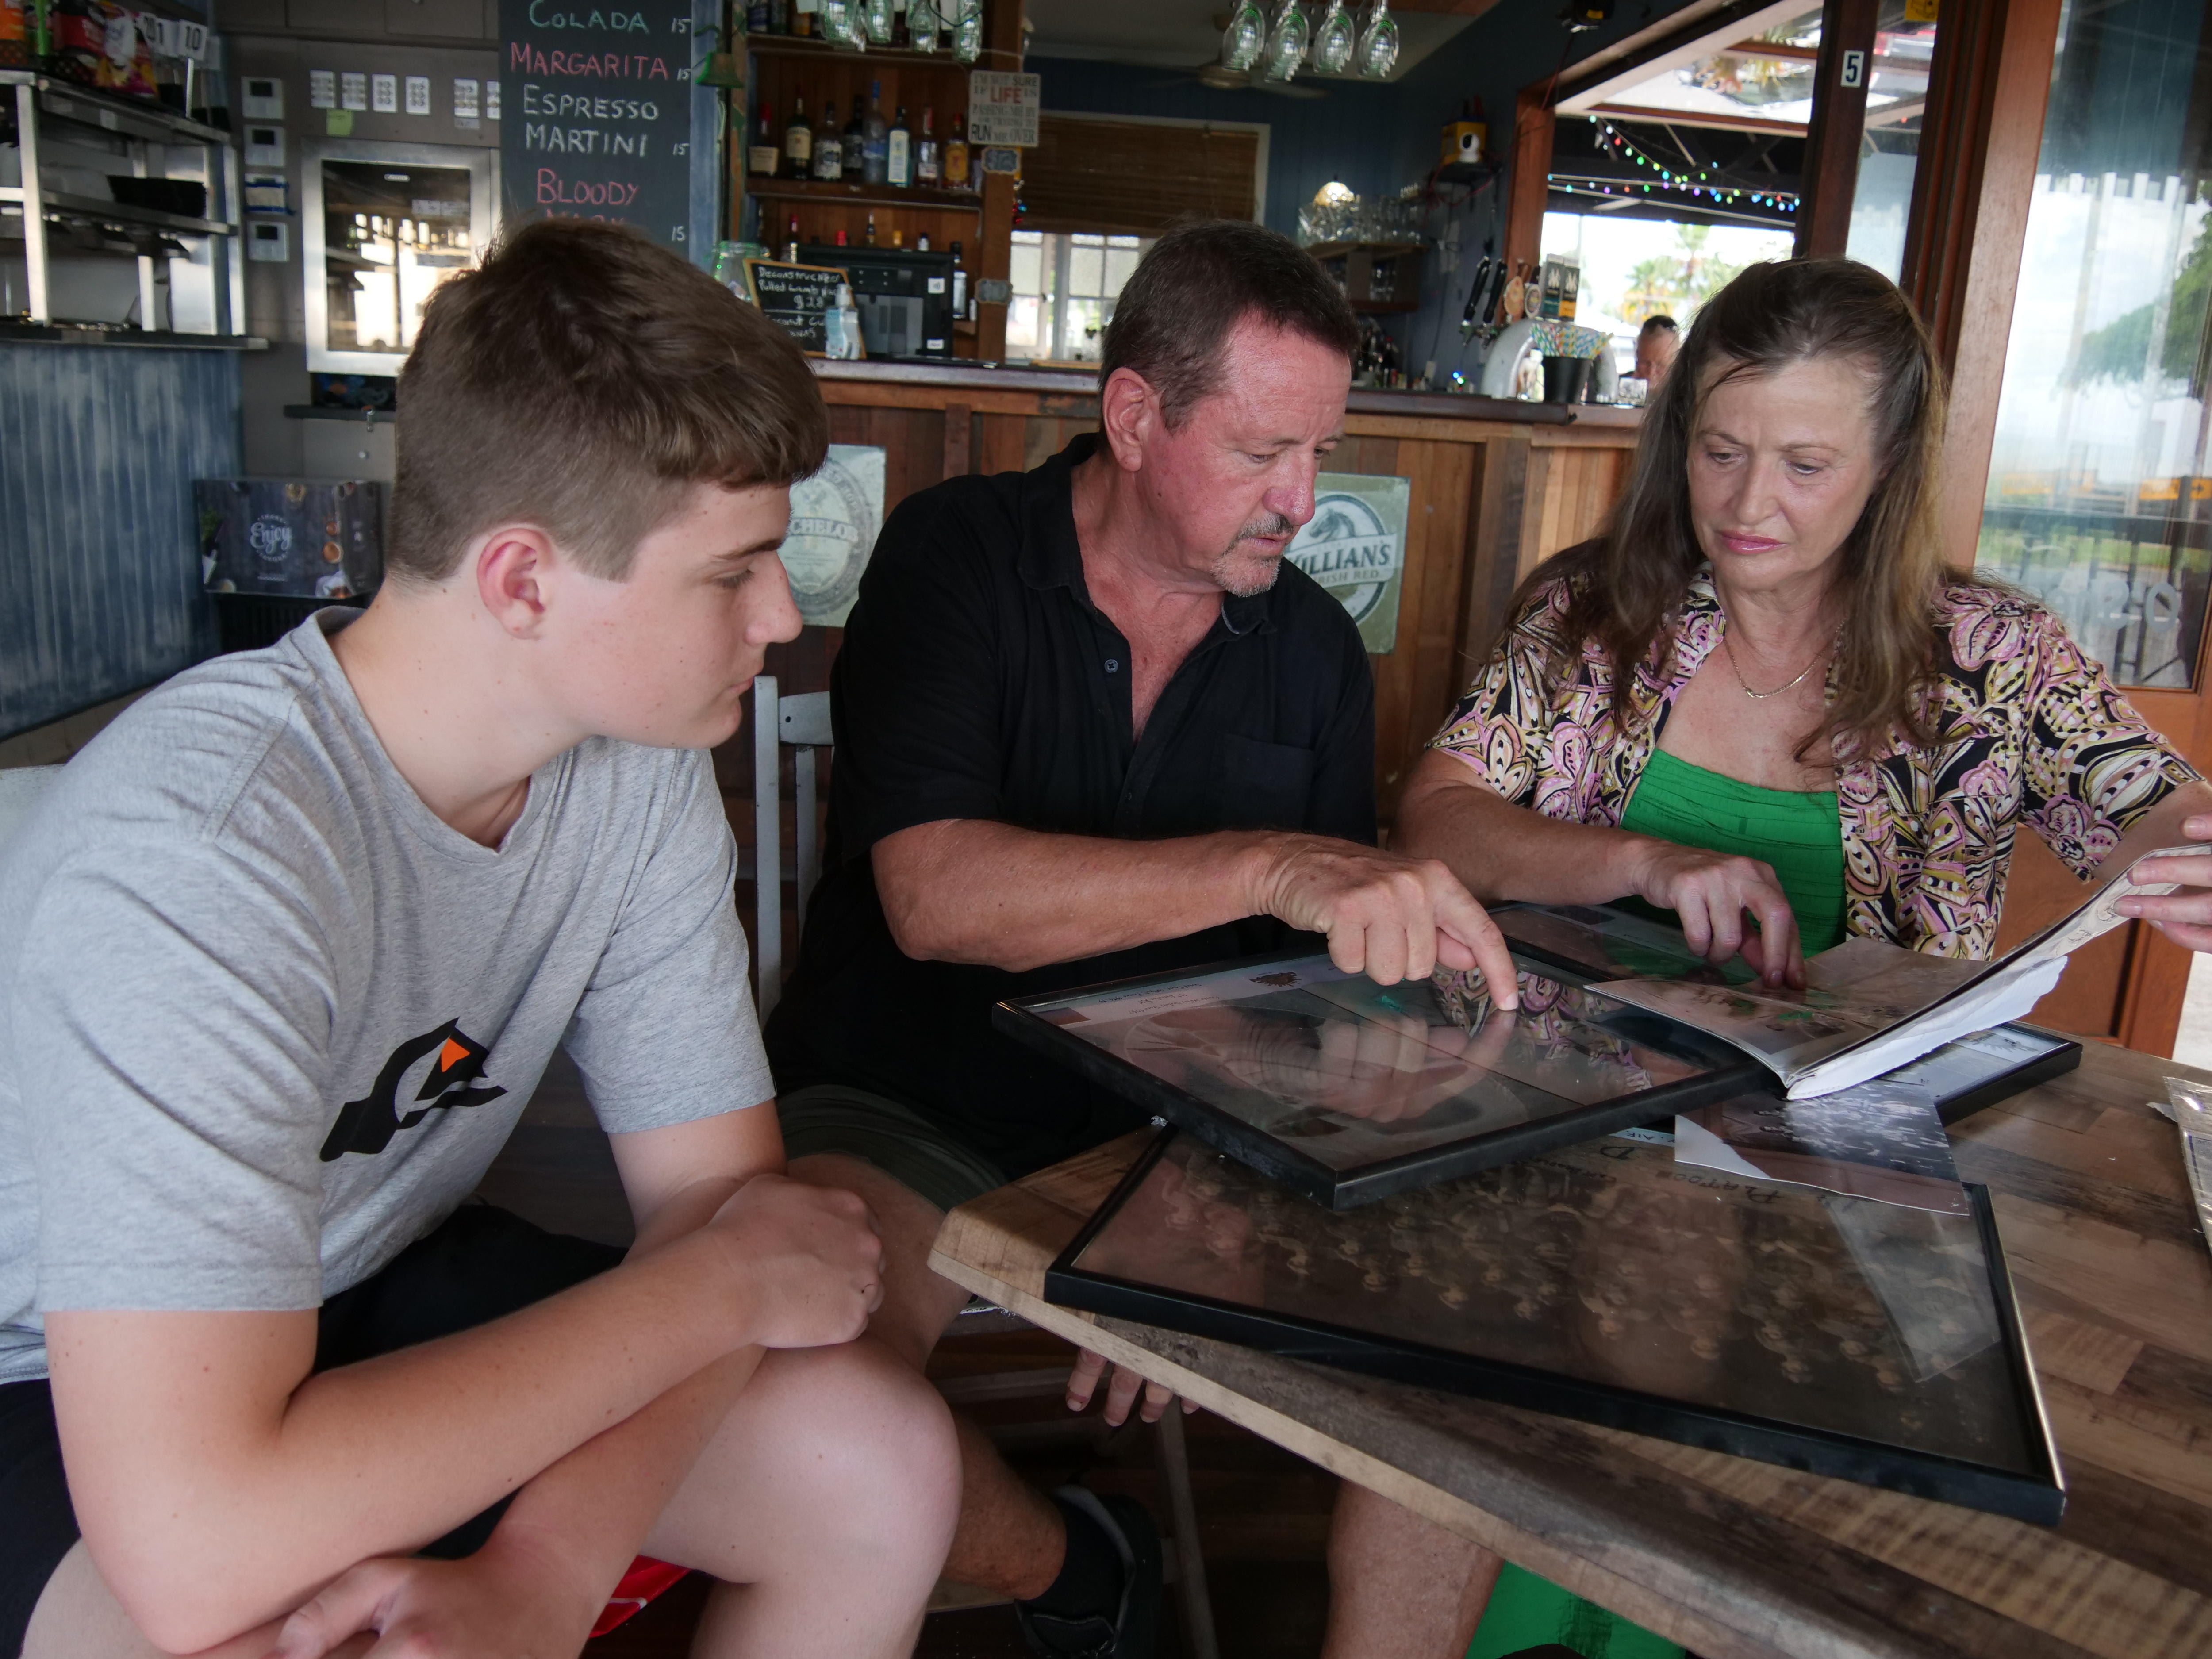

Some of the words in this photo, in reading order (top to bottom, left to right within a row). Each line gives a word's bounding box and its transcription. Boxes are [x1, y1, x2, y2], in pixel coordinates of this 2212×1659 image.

[183, 24, 203, 50] 10
[671, 18, 691, 34] 15
[511, 42, 669, 80] MARGARITA
[677, 68, 691, 81] 15
[1846, 55, 1859, 82] 5
[523, 84, 659, 121] ESPRESSO
[991, 86, 1022, 103] LIFE
[526, 123, 648, 157] MARTINI
[672, 142, 689, 156] 15
[537, 168, 640, 205] BLOODY
[671, 226, 686, 242] 15
[250, 521, 292, 554] Enjoy
